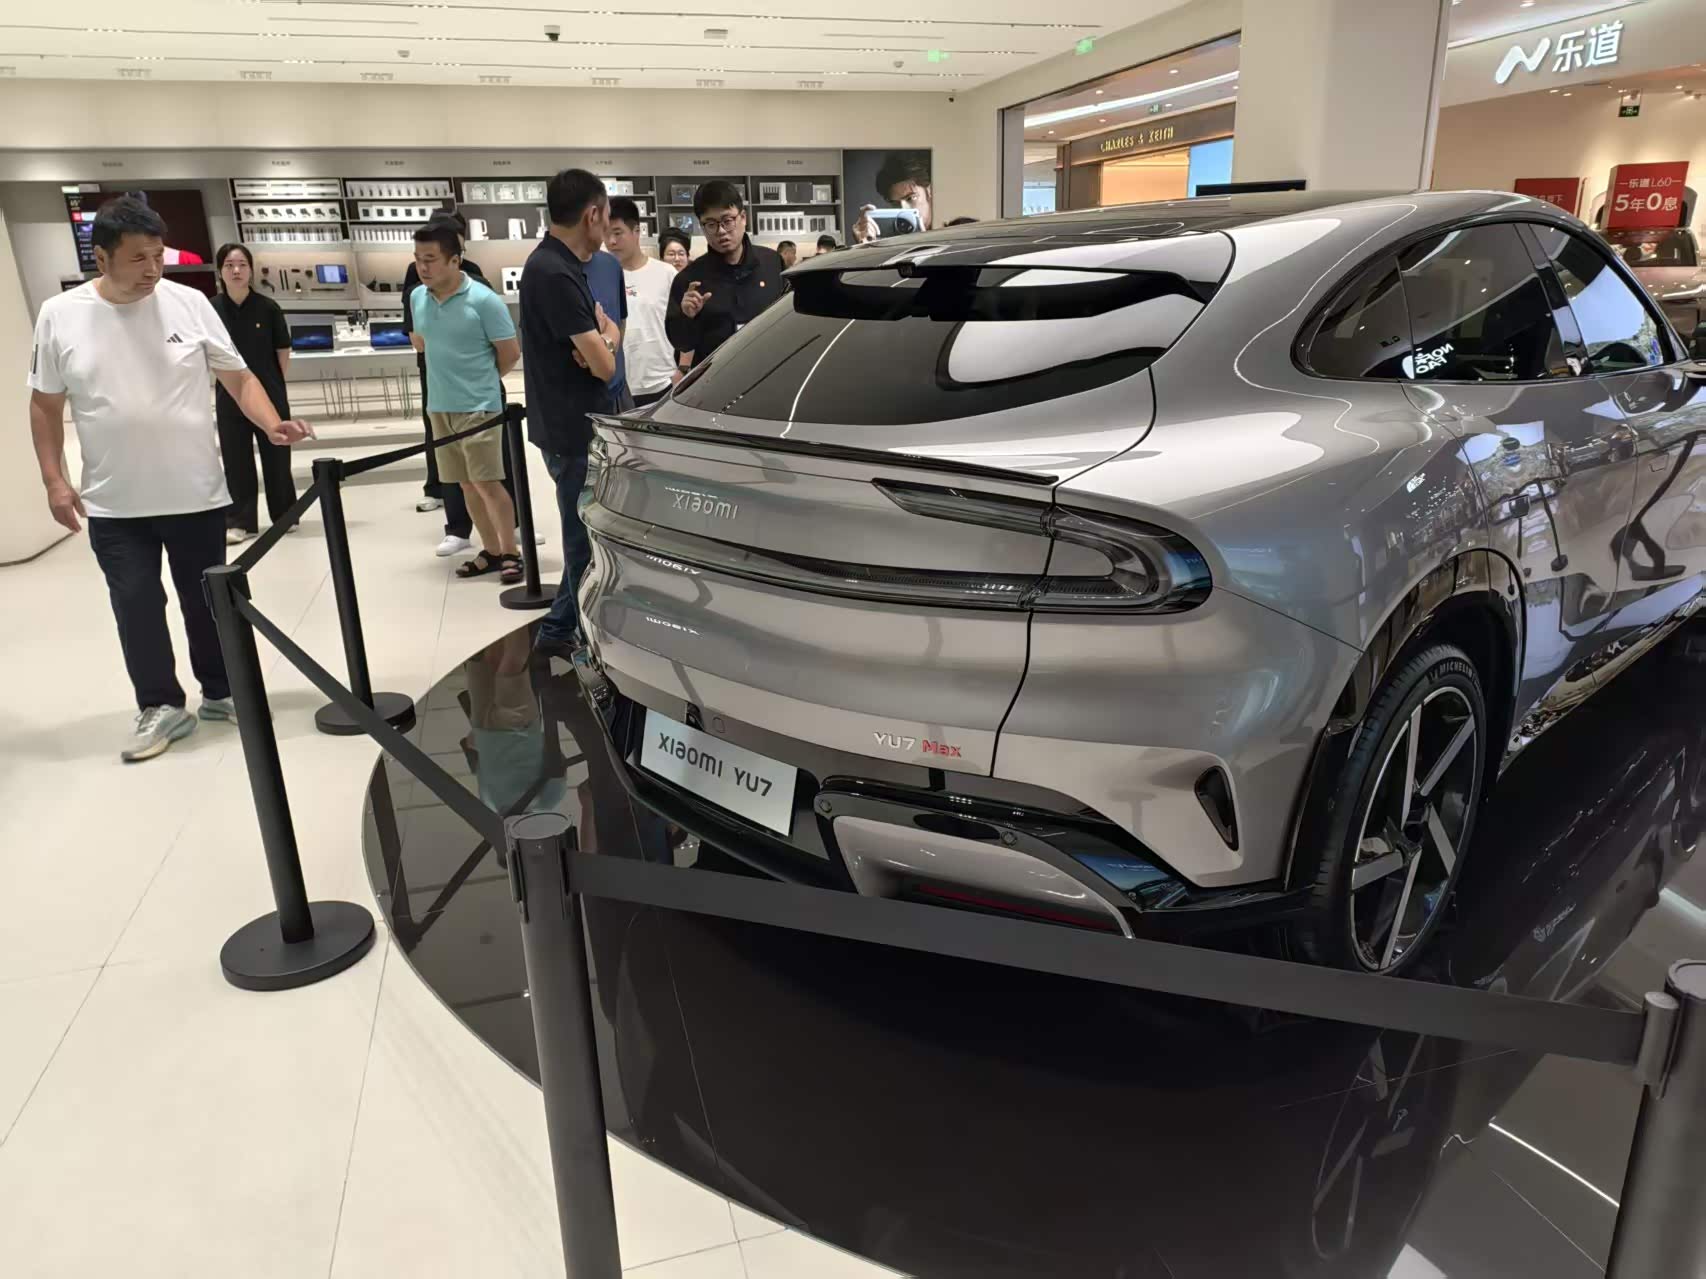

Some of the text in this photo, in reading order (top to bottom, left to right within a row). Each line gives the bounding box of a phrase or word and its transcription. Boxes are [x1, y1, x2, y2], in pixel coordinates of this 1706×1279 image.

[1552, 20, 1623, 72] 乐道
[1100, 136, 1134, 152] CHARLES
[1149, 126, 1174, 143] KEITH
[1614, 192, 1678, 212] 5年0息
[1440, 660, 1473, 678] MICHELIN
[873, 731, 962, 757] YU7 Max
[734, 766, 773, 797] YU7
